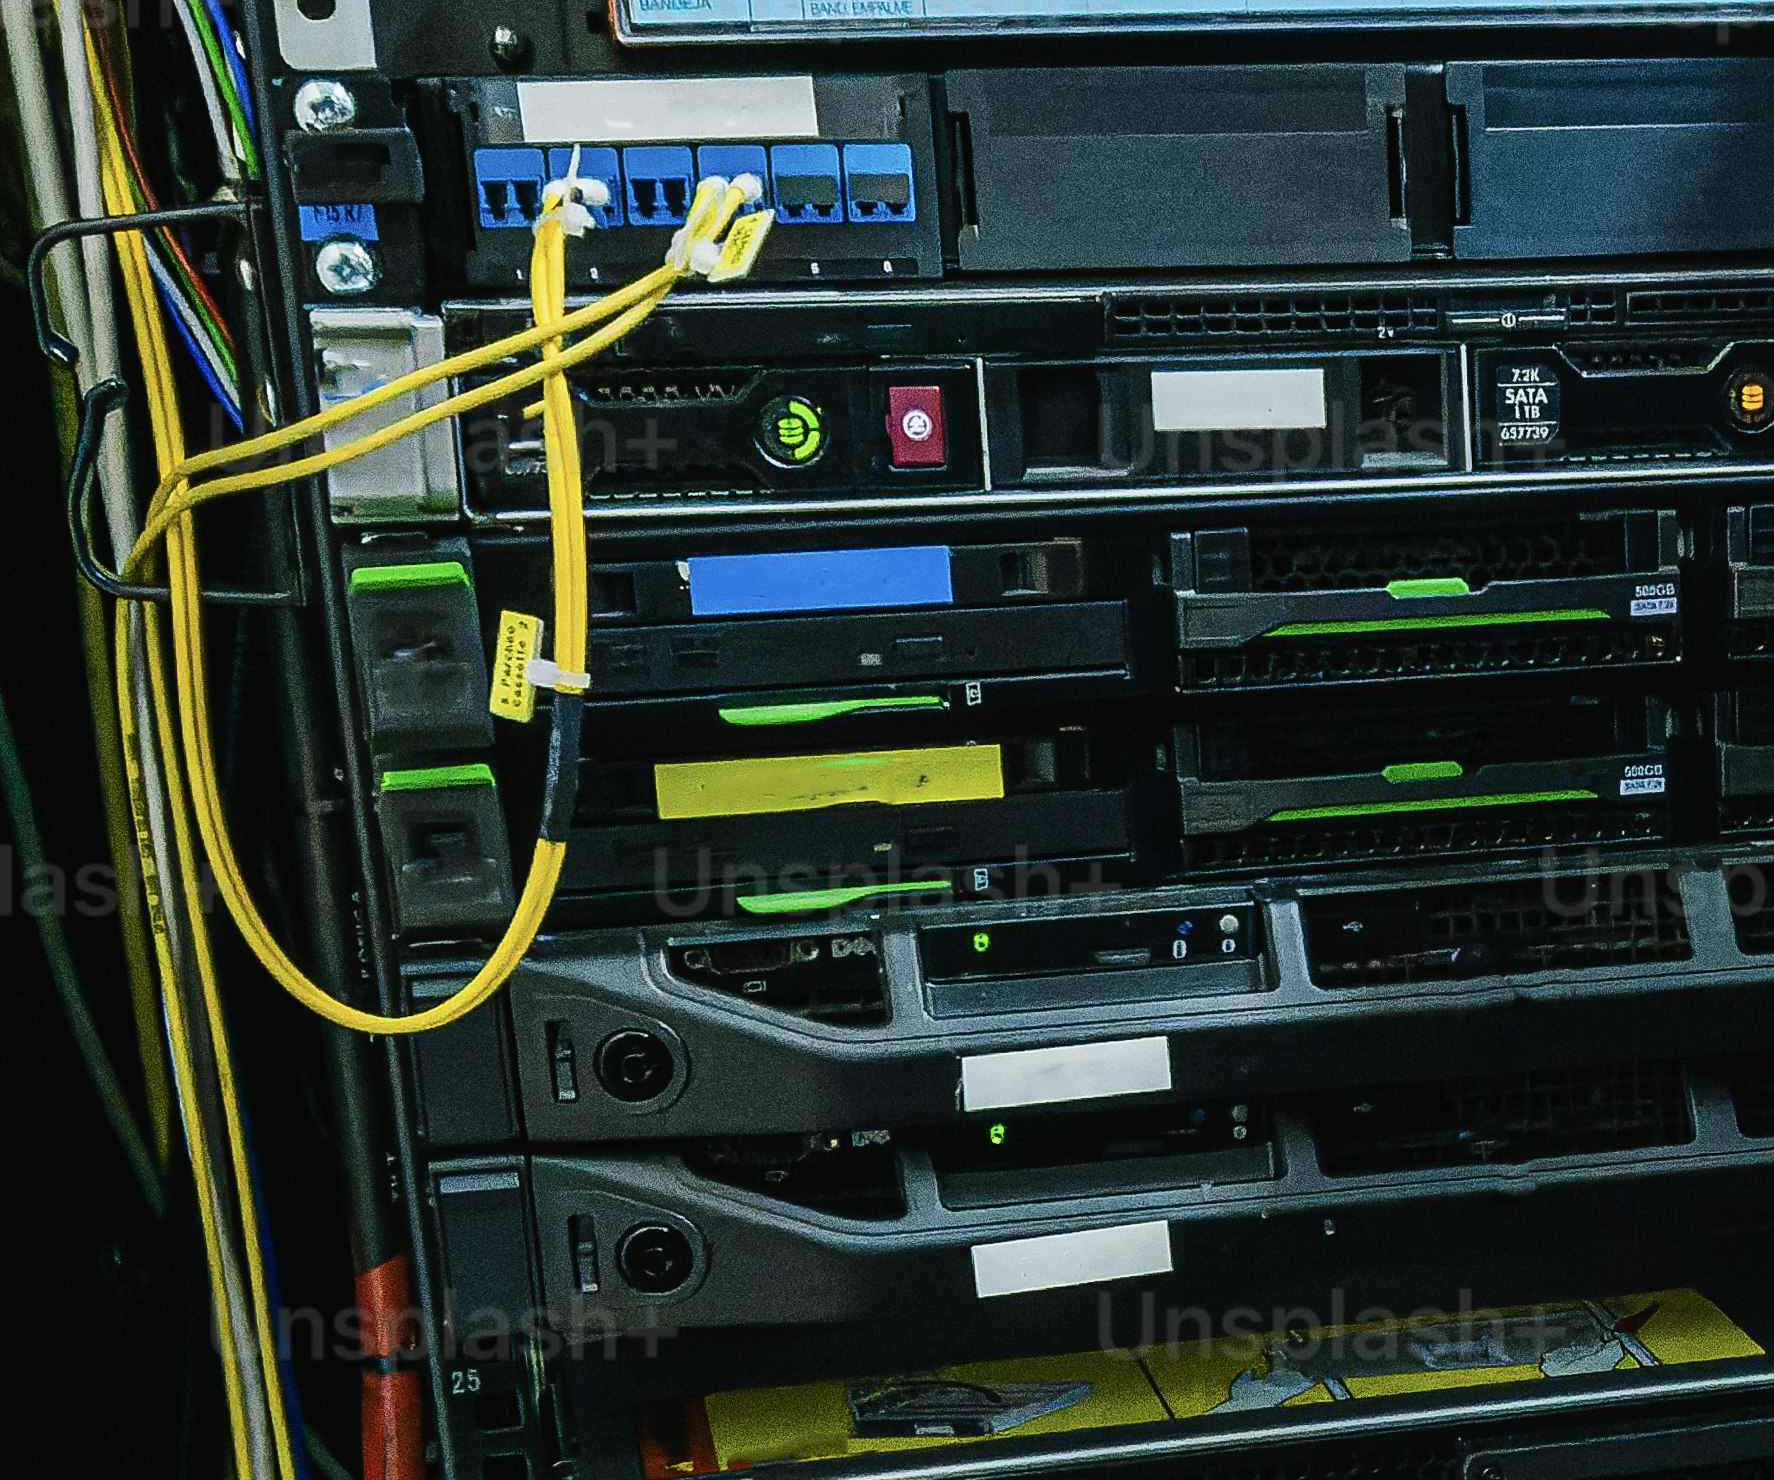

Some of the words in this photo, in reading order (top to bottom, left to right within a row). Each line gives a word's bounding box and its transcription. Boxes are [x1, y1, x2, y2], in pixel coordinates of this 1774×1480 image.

[1512, 367, 1539, 382] 7.2K
[1505, 387, 1548, 404] SATA
[452, 1367, 482, 1394] 25
